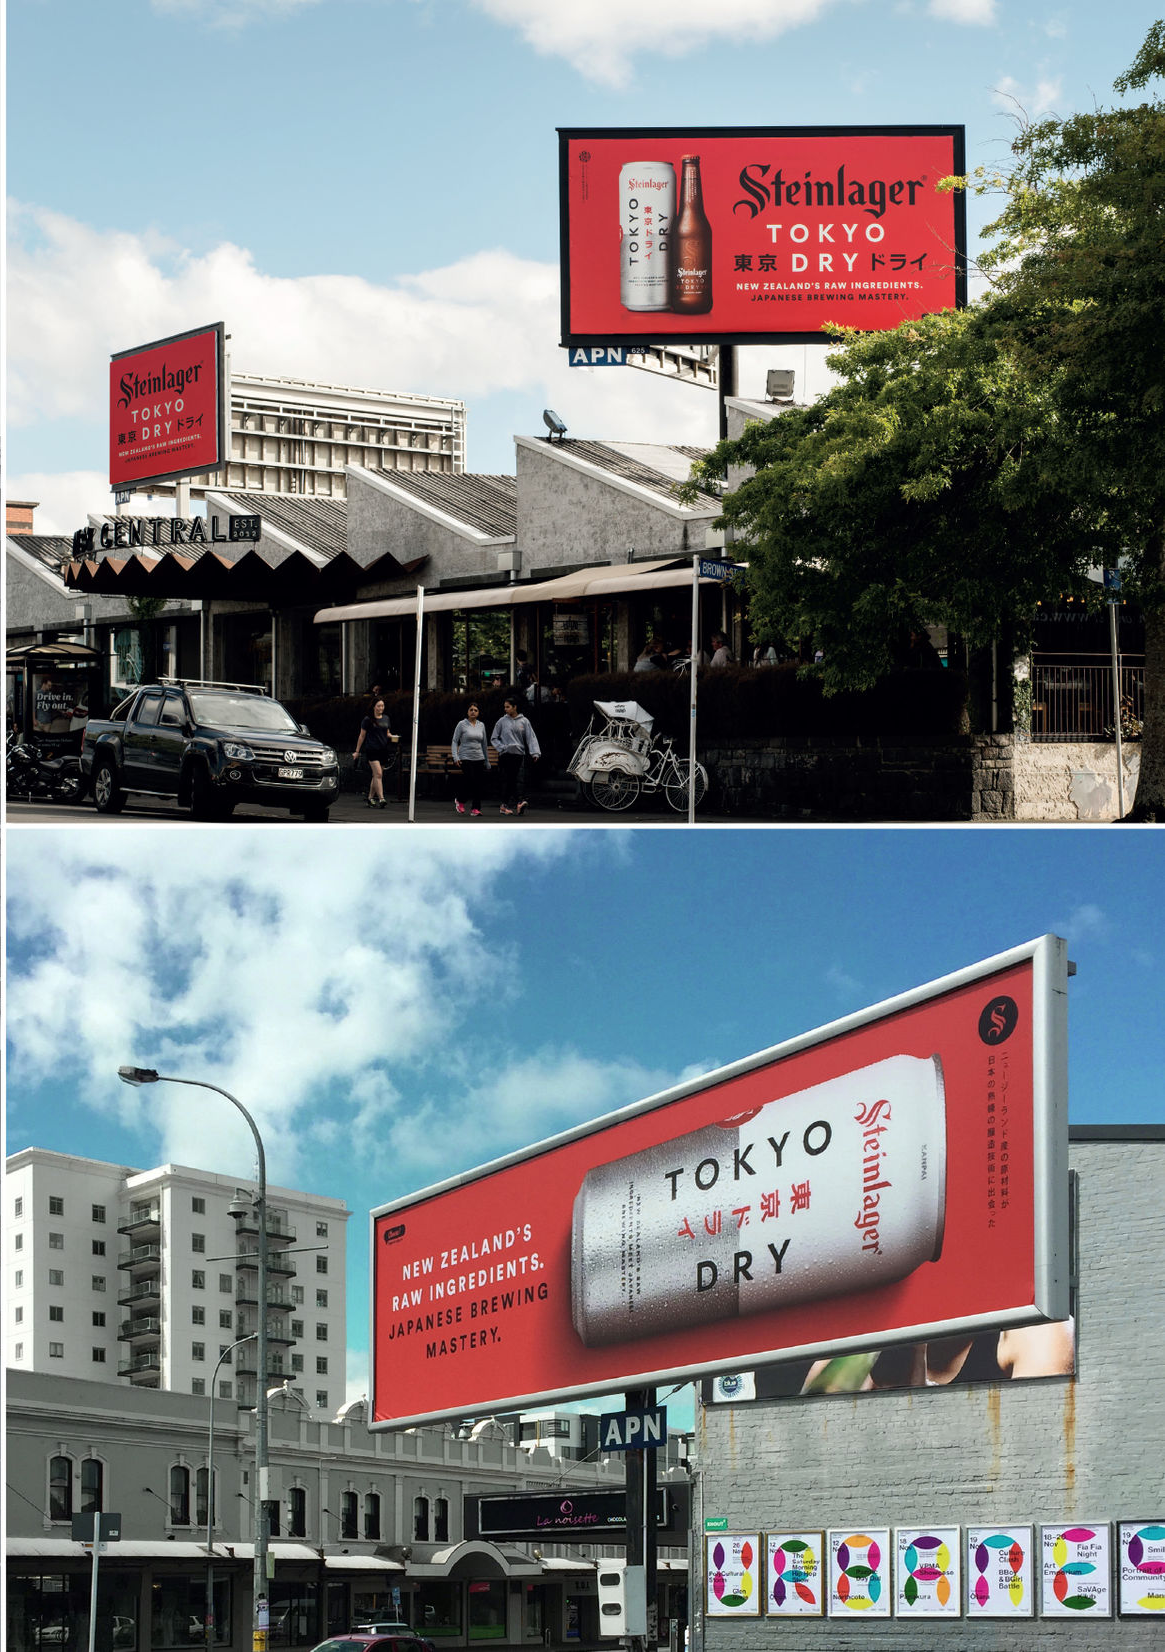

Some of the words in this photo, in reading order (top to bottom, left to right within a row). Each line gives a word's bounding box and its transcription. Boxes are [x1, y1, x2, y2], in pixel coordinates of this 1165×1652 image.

[733, 164, 925, 219] Steinlager
[629, 198, 639, 266] TOKYO
[659, 213, 668, 251] DRY
[767, 223, 885, 243] TOKYO
[733, 254, 777, 272] 東京
[791, 253, 858, 273] DRY
[872, 253, 927, 271] ドライ
[763, 282, 820, 290] ZEALAND'S
[851, 281, 923, 289] INGREDIENTS.
[807, 293, 854, 301] BREWING
[859, 293, 909, 301] MASTERY.
[572, 347, 622, 364] APN
[117, 362, 203, 410] Steinlager
[132, 398, 184, 424] TOKYO
[142, 421, 172, 441] DRY
[177, 413, 204, 432] ドライ
[116, 490, 130, 504] APN
[100, 516, 226, 549] CENTRAL
[234, 519, 258, 529] EST.
[703, 561, 726, 577] BROWN
[37, 693, 61, 701] Drive
[37, 701, 50, 711] Fly
[665, 1120, 832, 1201] TOKYO
[853, 1098, 893, 1252] Steinlager
[403, 1256, 433, 1281] NEW
[441, 1223, 532, 1270] ZEALAND’S
[697, 1238, 792, 1293] DRY
[392, 1288, 422, 1312] RAW
[430, 1252, 544, 1301] INGREDIENTS.
[389, 1306, 462, 1340] JAPANESE
[471, 1282, 548, 1319] BREWING
[426, 1326, 501, 1359] MASTERY.
[605, 1412, 661, 1446] APN
[537, 1515, 553, 1527] La
[555, 1513, 599, 1525] noisette
[1123, 1531, 1131, 1539] 19
[1077, 1551, 1097, 1559] Night
[1044, 1569, 1082, 1577] Emporium
[1123, 1566, 1152, 1574] Portrait
[1154, 1566, 1163, 1574] of
